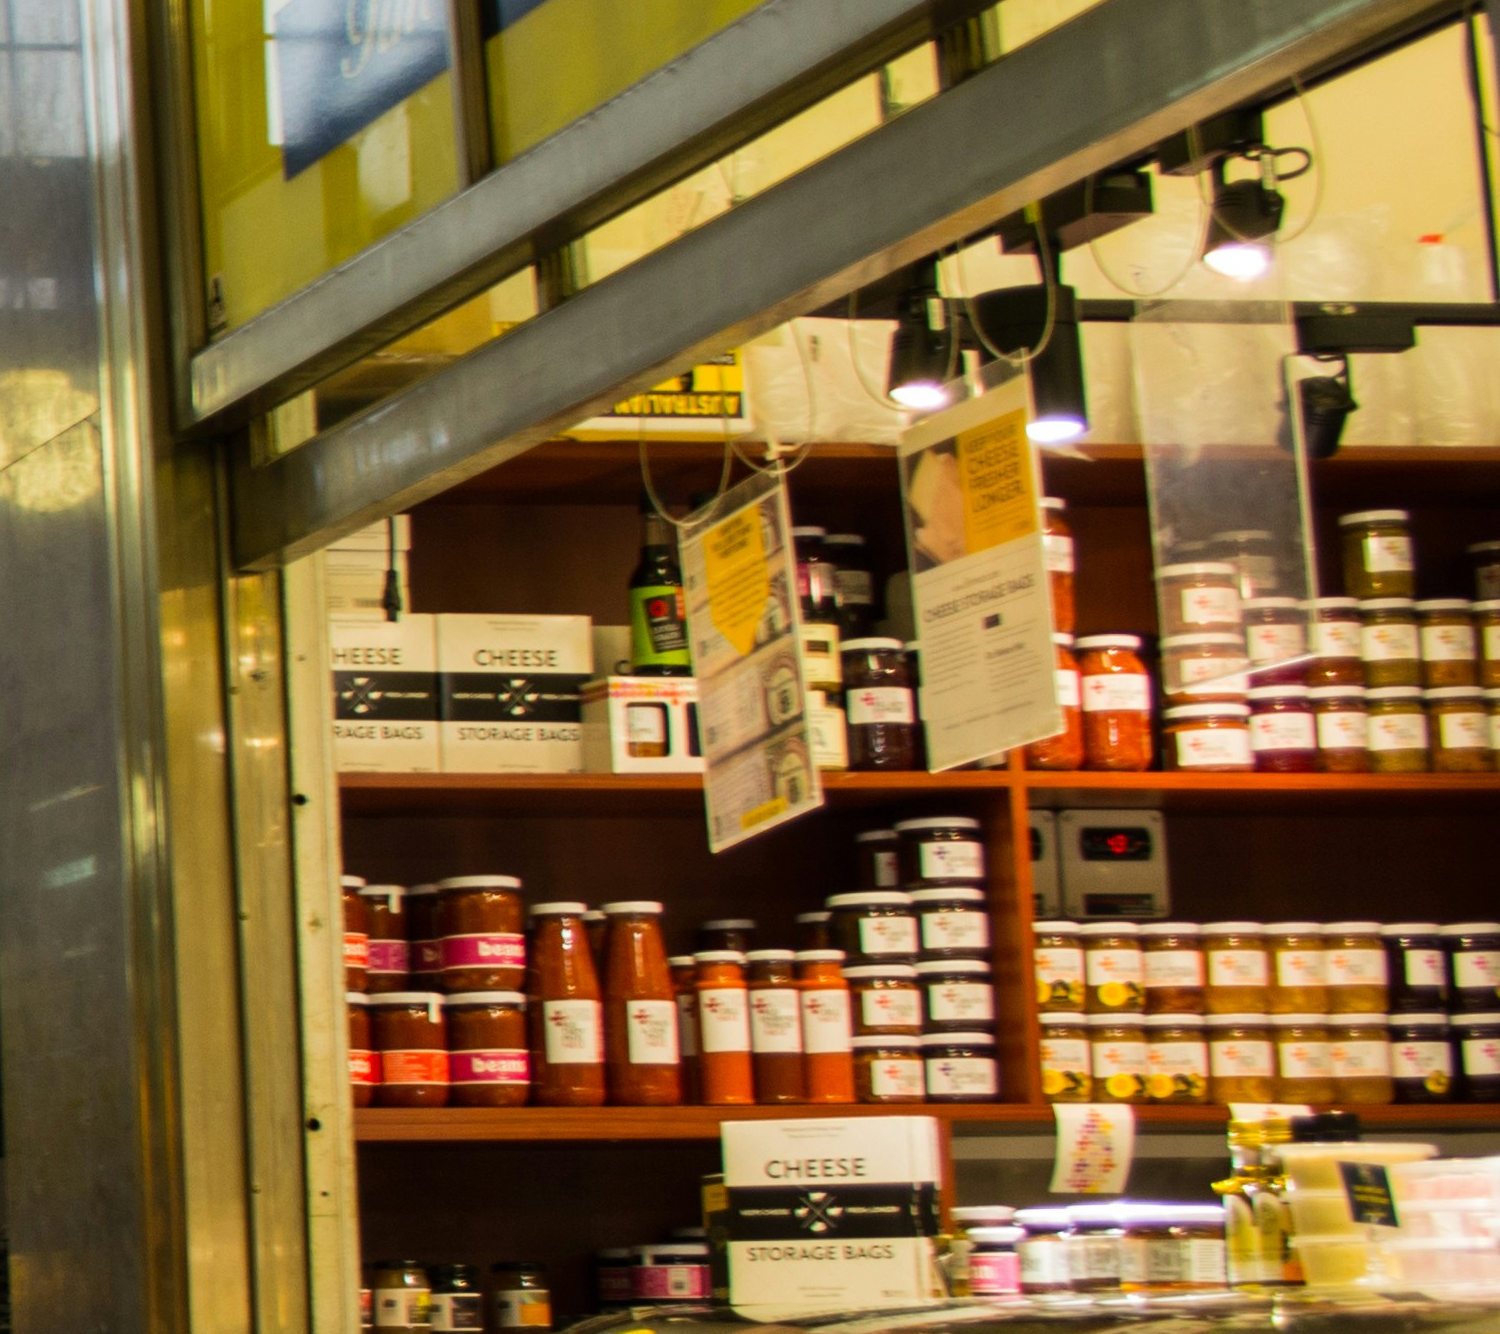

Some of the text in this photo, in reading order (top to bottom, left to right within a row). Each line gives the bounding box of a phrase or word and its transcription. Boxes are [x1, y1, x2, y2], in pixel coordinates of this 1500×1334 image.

[333, 647, 403, 665] HEESE
[473, 648, 558, 667] CHEESE
[333, 726, 424, 740] RAGE BAGS
[457, 726, 580, 741] STORAGE BAGS
[764, 1157, 867, 1179] CHEESE
[746, 1244, 895, 1263] STORAGE BAGS
